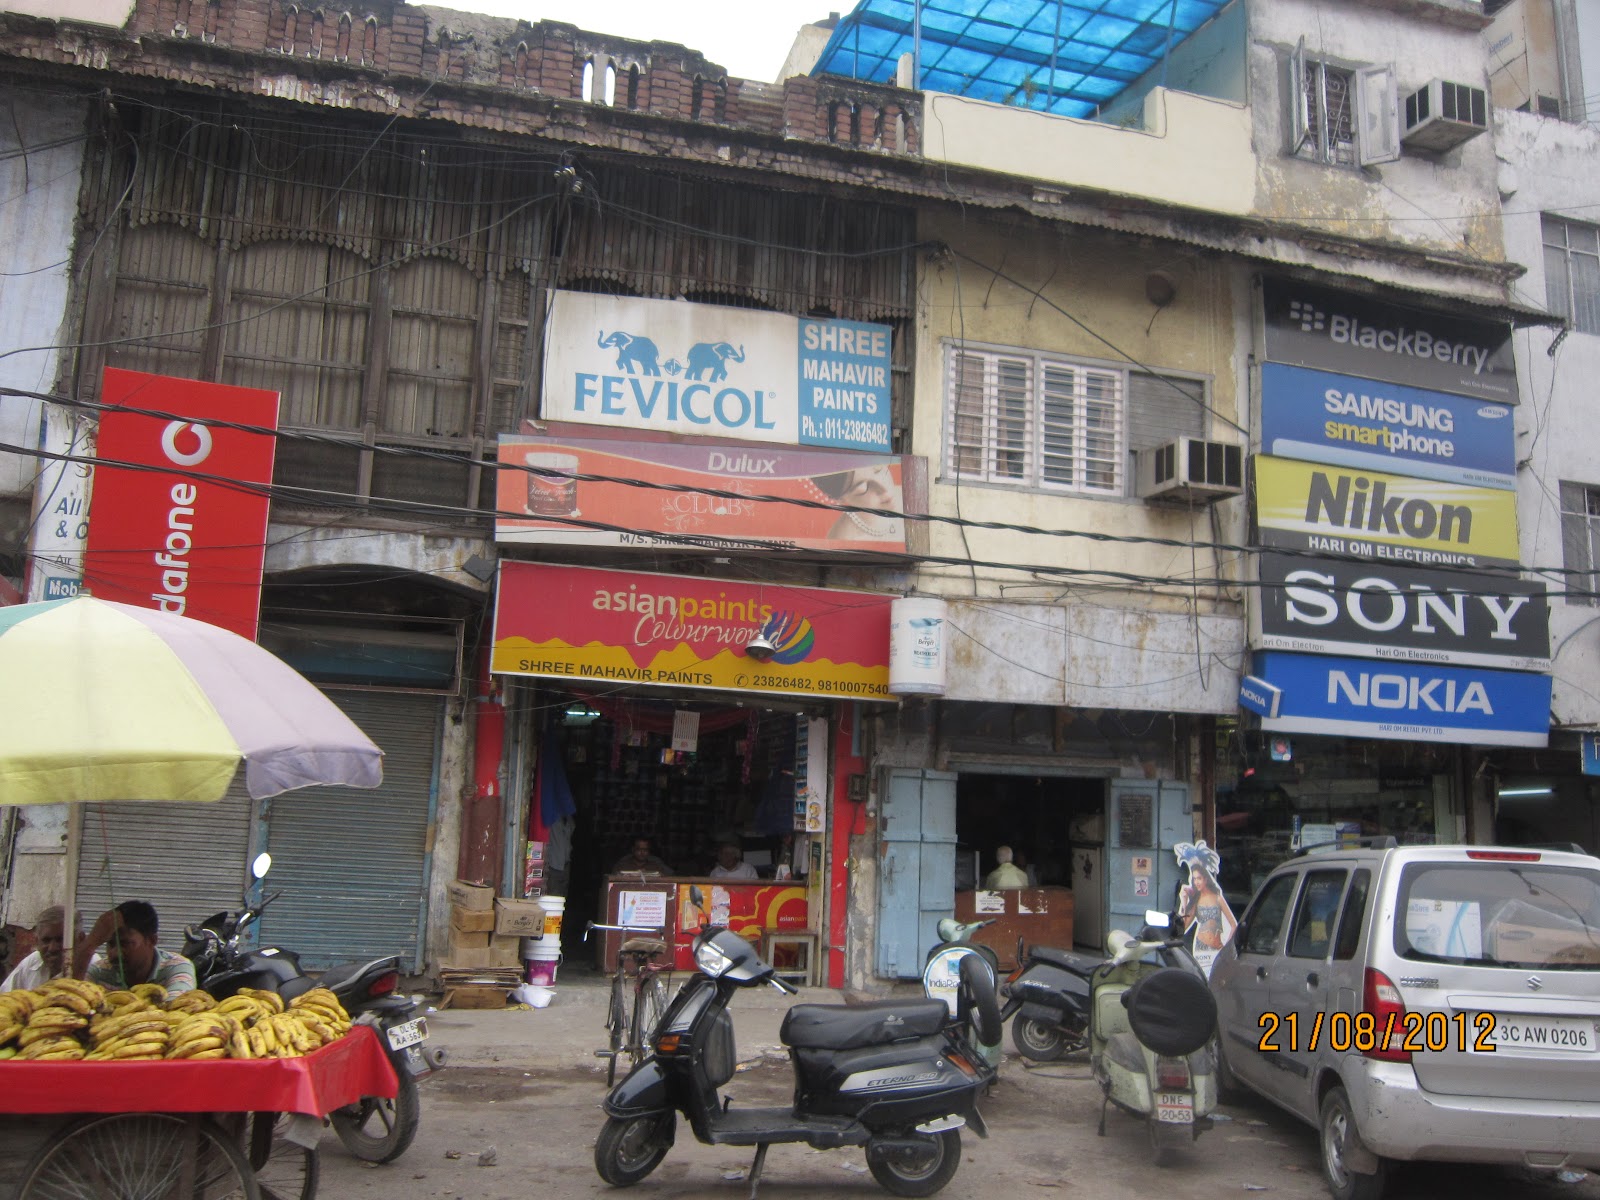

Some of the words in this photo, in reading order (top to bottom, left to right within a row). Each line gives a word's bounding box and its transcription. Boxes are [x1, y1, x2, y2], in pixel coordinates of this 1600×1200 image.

[803, 324, 886, 357] SHREE
[1330, 314, 1488, 375] BlackBerry
[803, 359, 886, 388] MAHAVIR
[573, 373, 776, 429] FEVICOL
[813, 387, 878, 414] PAINTS
[1324, 389, 1454, 433] SAMSUNG
[825, 418, 888, 445] 011-23826482
[1325, 420, 1454, 457] smartphone
[708, 452, 777, 474] Dulux
[1305, 471, 1472, 545] Nikon
[55, 520, 68, 540] &
[619, 533, 648, 544] M/S.
[1308, 536, 1345, 553] HARI
[1350, 542, 1373, 556] OM
[1377, 545, 1476, 566] ELECTRONICS
[1284, 570, 1530, 641] SONY
[1375, 647, 1391, 656] Hari
[1393, 649, 1407, 657] Om
[1408, 650, 1449, 661] Electronics
[519, 659, 575, 674] SHREE
[580, 664, 652, 681] MAHAVIR
[658, 670, 713, 685] PAINTS
[753, 675, 815, 691] 23826482,
[818, 680, 889, 695] 9810007540
[1240, 686, 1266, 708] NOKIA
[1327, 670, 1494, 715] NOKIA
[513, 919, 532, 927] Berger
[1551, 1028, 1587, 1047] 0206
[867, 1075, 916, 1087] ETERNO
